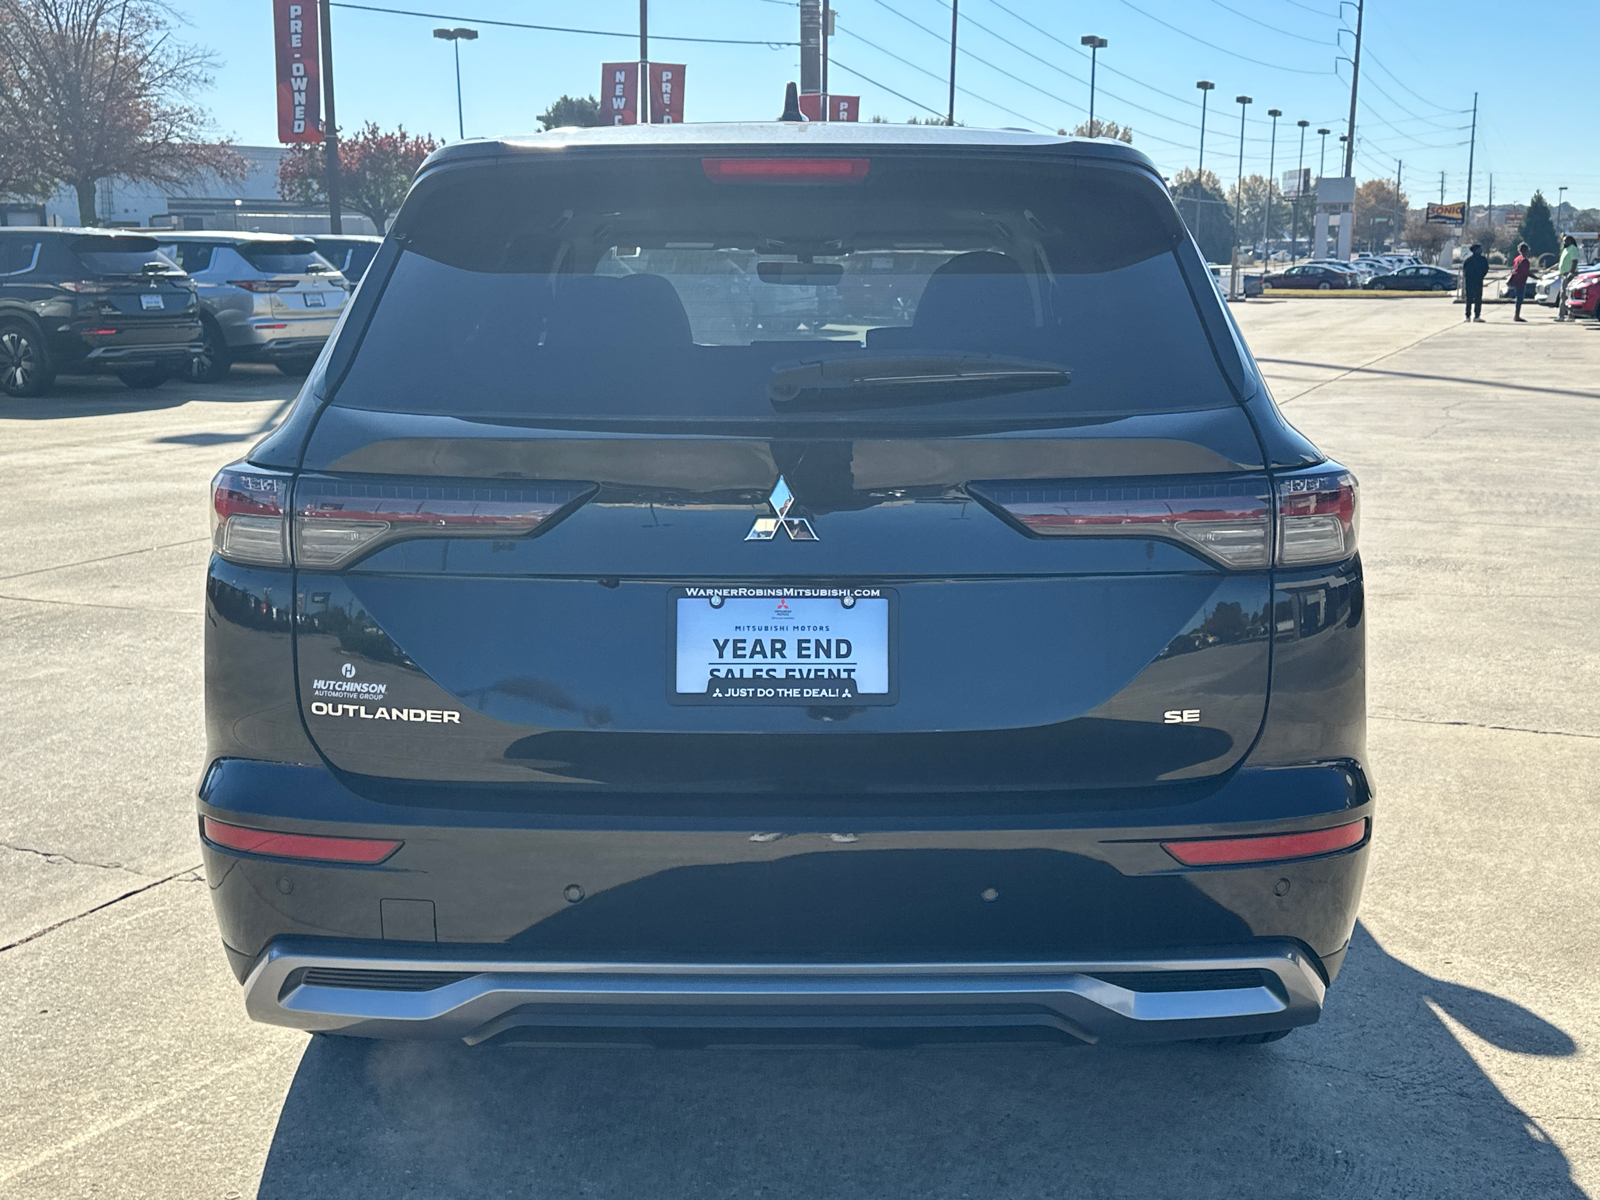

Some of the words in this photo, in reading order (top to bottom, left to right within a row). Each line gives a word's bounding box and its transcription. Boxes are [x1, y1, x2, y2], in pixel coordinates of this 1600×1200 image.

[289, 4, 308, 134] PRE-OWNED
[612, 70, 626, 110] NEW
[1430, 206, 1462, 215] SONIC
[712, 638, 787, 659] YEAR
[797, 638, 853, 659] END
[709, 668, 777, 679] SALES
[785, 668, 856, 680] EVENT
[313, 679, 386, 694] HUTCHINSON
[724, 688, 755, 698] JUST
[757, 688, 775, 698] DO
[777, 688, 801, 698] THE
[803, 688, 839, 698] DEAL!
[314, 690, 358, 699] AUTOMOTIVE
[359, 693, 384, 701] GROUP
[311, 702, 461, 724] OUTLANDER
[1164, 709, 1201, 724] SE
